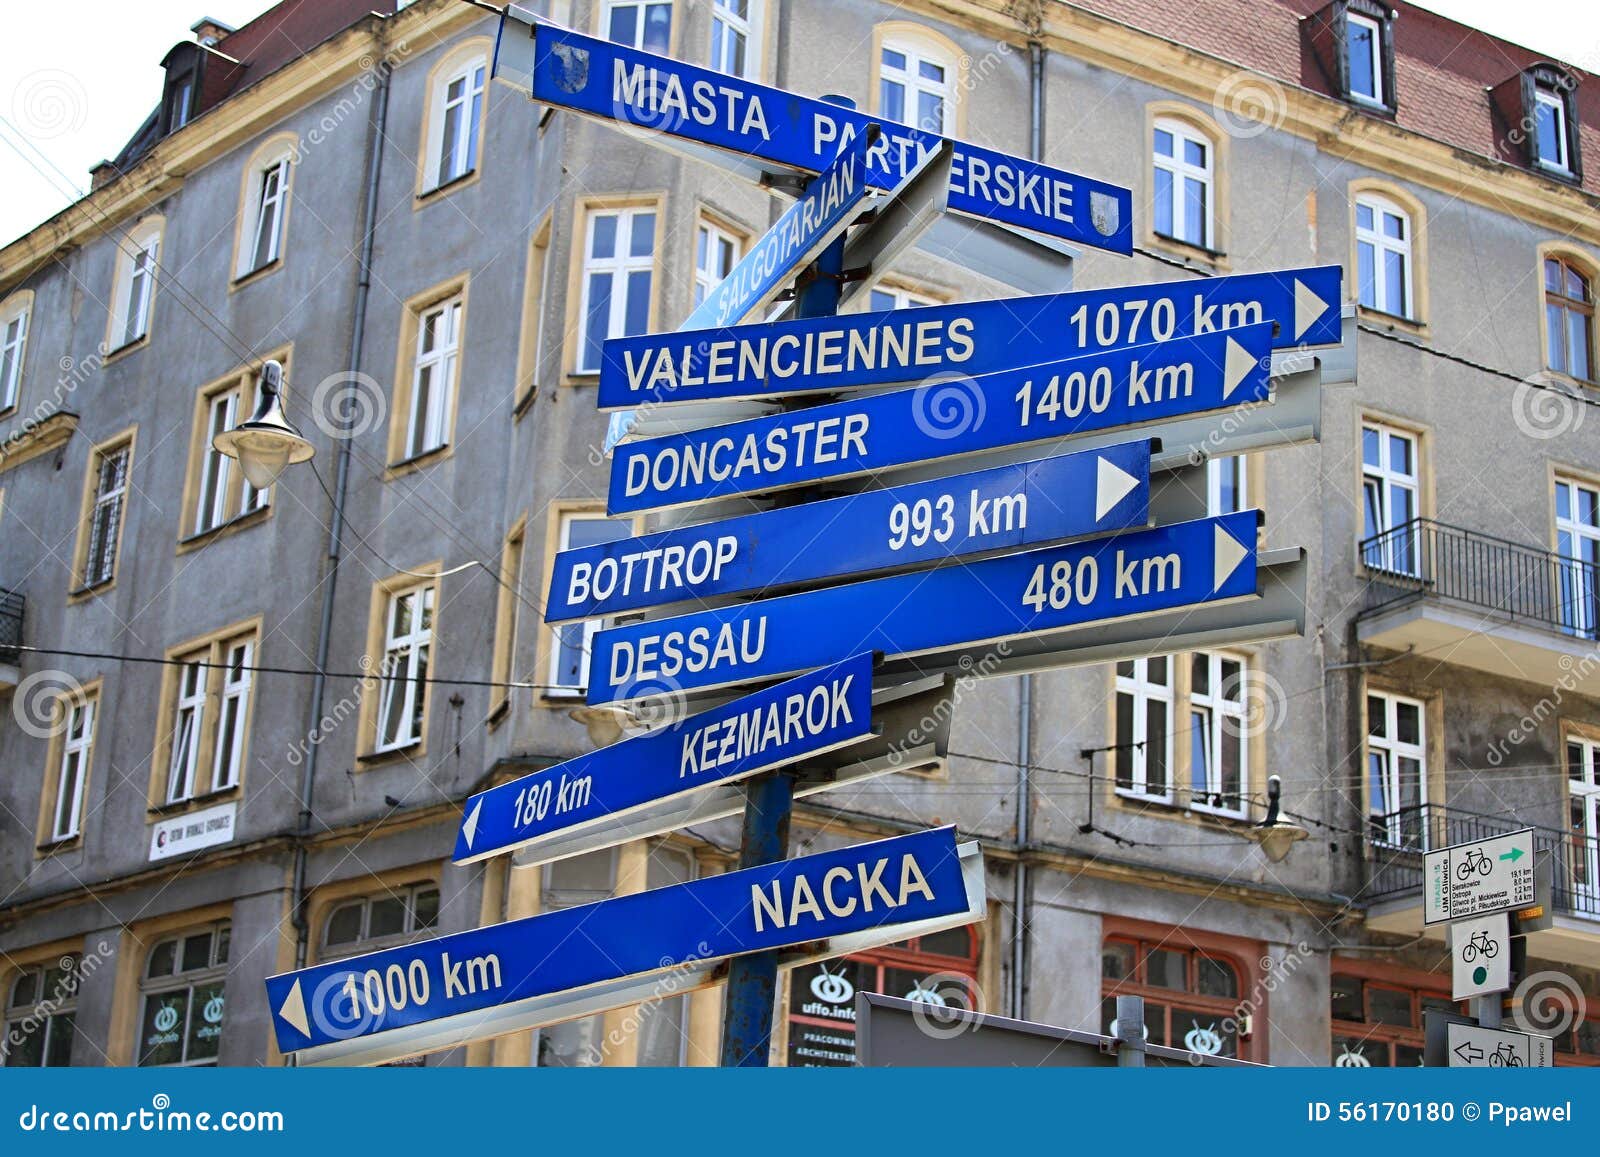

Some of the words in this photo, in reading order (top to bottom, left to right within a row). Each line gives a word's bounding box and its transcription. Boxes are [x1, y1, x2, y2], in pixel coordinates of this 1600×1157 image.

[613, 58, 770, 140] MIASTA
[716, 151, 855, 326] SALGÓTARJÁN
[623, 318, 974, 391] VALENCIENNES
[1070, 298, 1175, 348] 1070
[1194, 295, 1263, 336] km
[626, 413, 869, 497] DONCASTER
[1015, 366, 1112, 427] 1400
[1128, 360, 1194, 406] km
[567, 536, 738, 603] BOTTROP
[888, 499, 955, 551] 993
[968, 489, 1028, 538] km
[609, 616, 767, 686] DESSAU
[1022, 556, 1098, 612] 480
[1115, 550, 1181, 598] km
[513, 780, 551, 829] 180
[556, 772, 592, 818] km
[342, 959, 430, 1020] 1000
[442, 952, 502, 999] km
[751, 854, 935, 932] NACKA
[1442, 896, 1449, 912] UM
